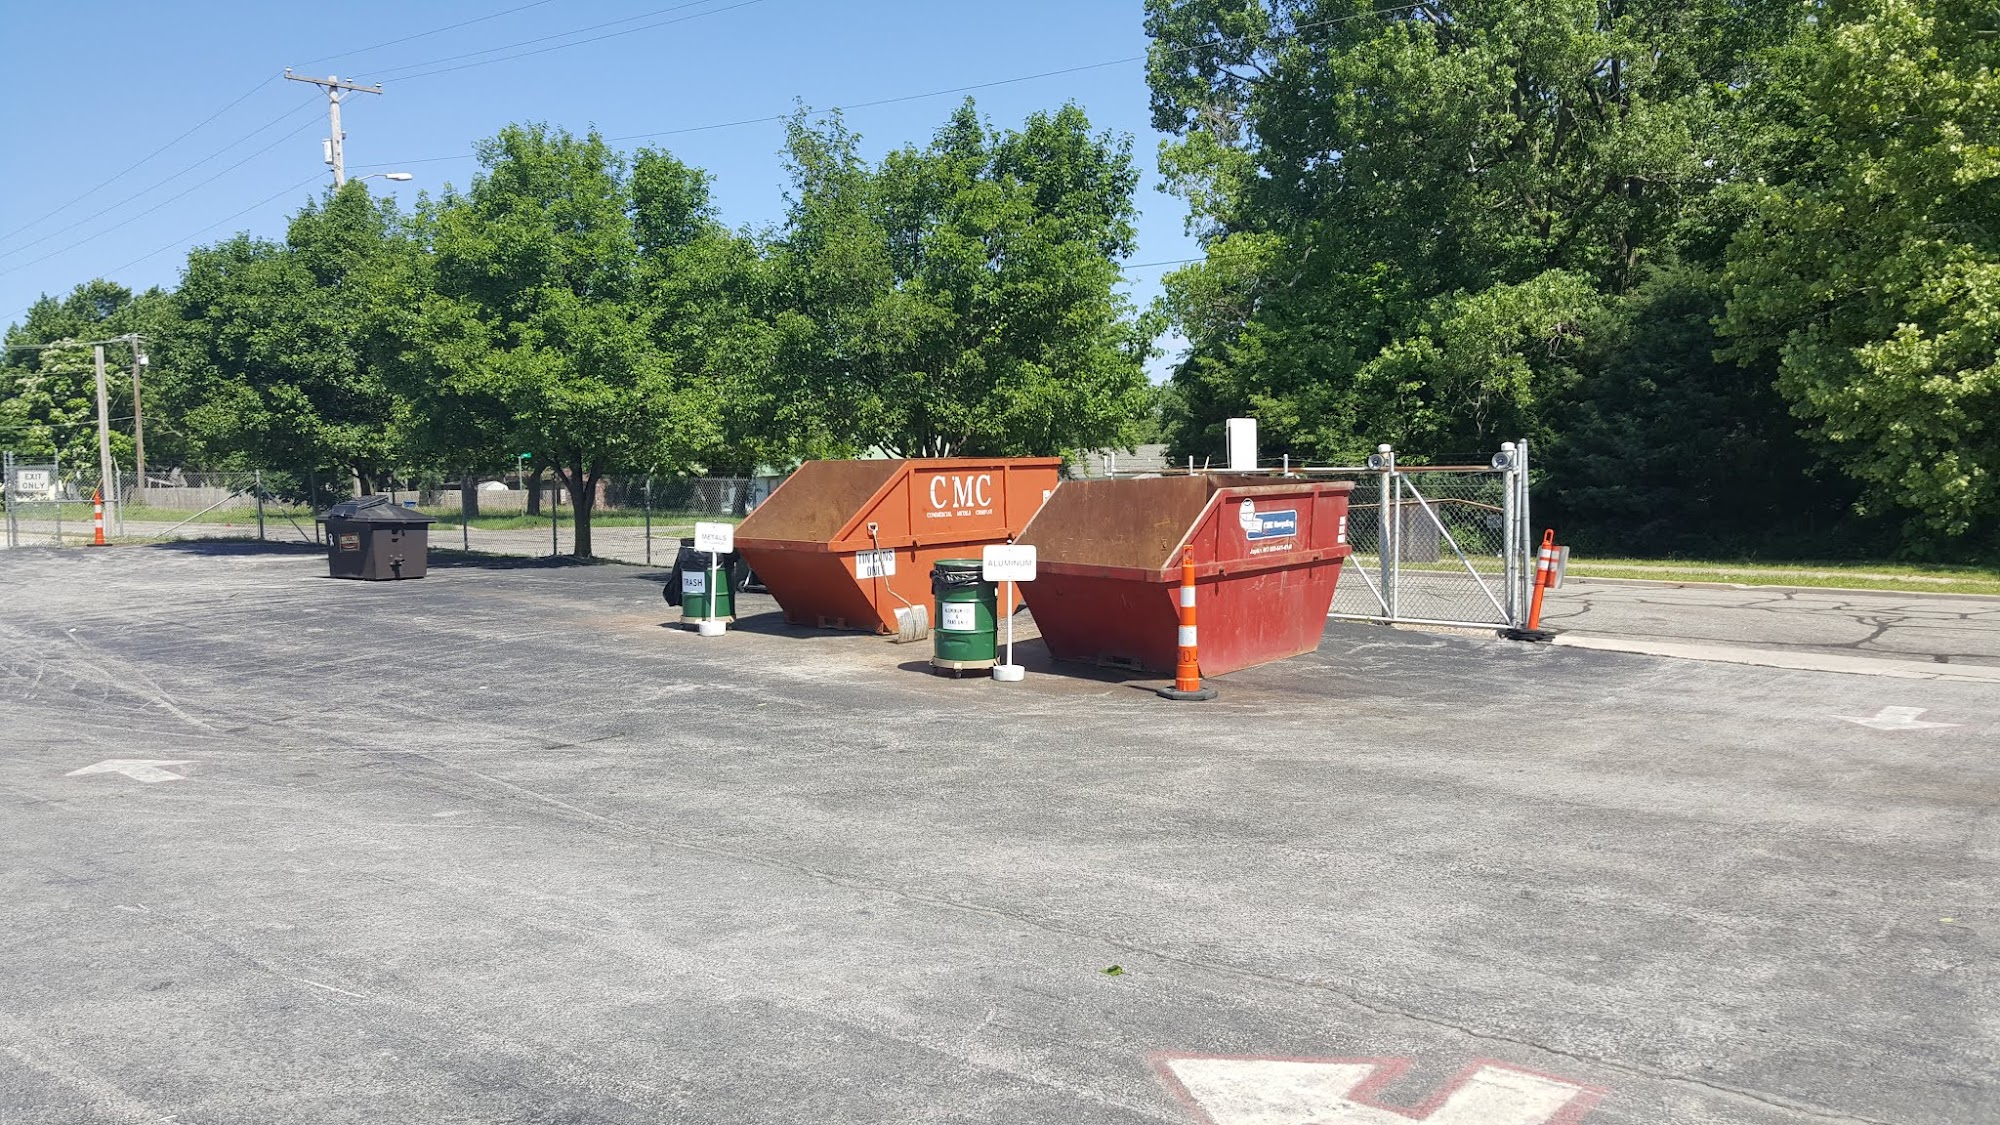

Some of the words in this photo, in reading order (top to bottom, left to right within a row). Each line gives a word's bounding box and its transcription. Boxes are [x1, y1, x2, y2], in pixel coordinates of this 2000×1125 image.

[929, 474, 992, 509] CMC
[701, 533, 727, 541] METALS
[857, 552, 871, 564] TIN
[987, 559, 1032, 567] ALUMINUM
[866, 565, 885, 577] ONL
[683, 578, 703, 587] TRASH
